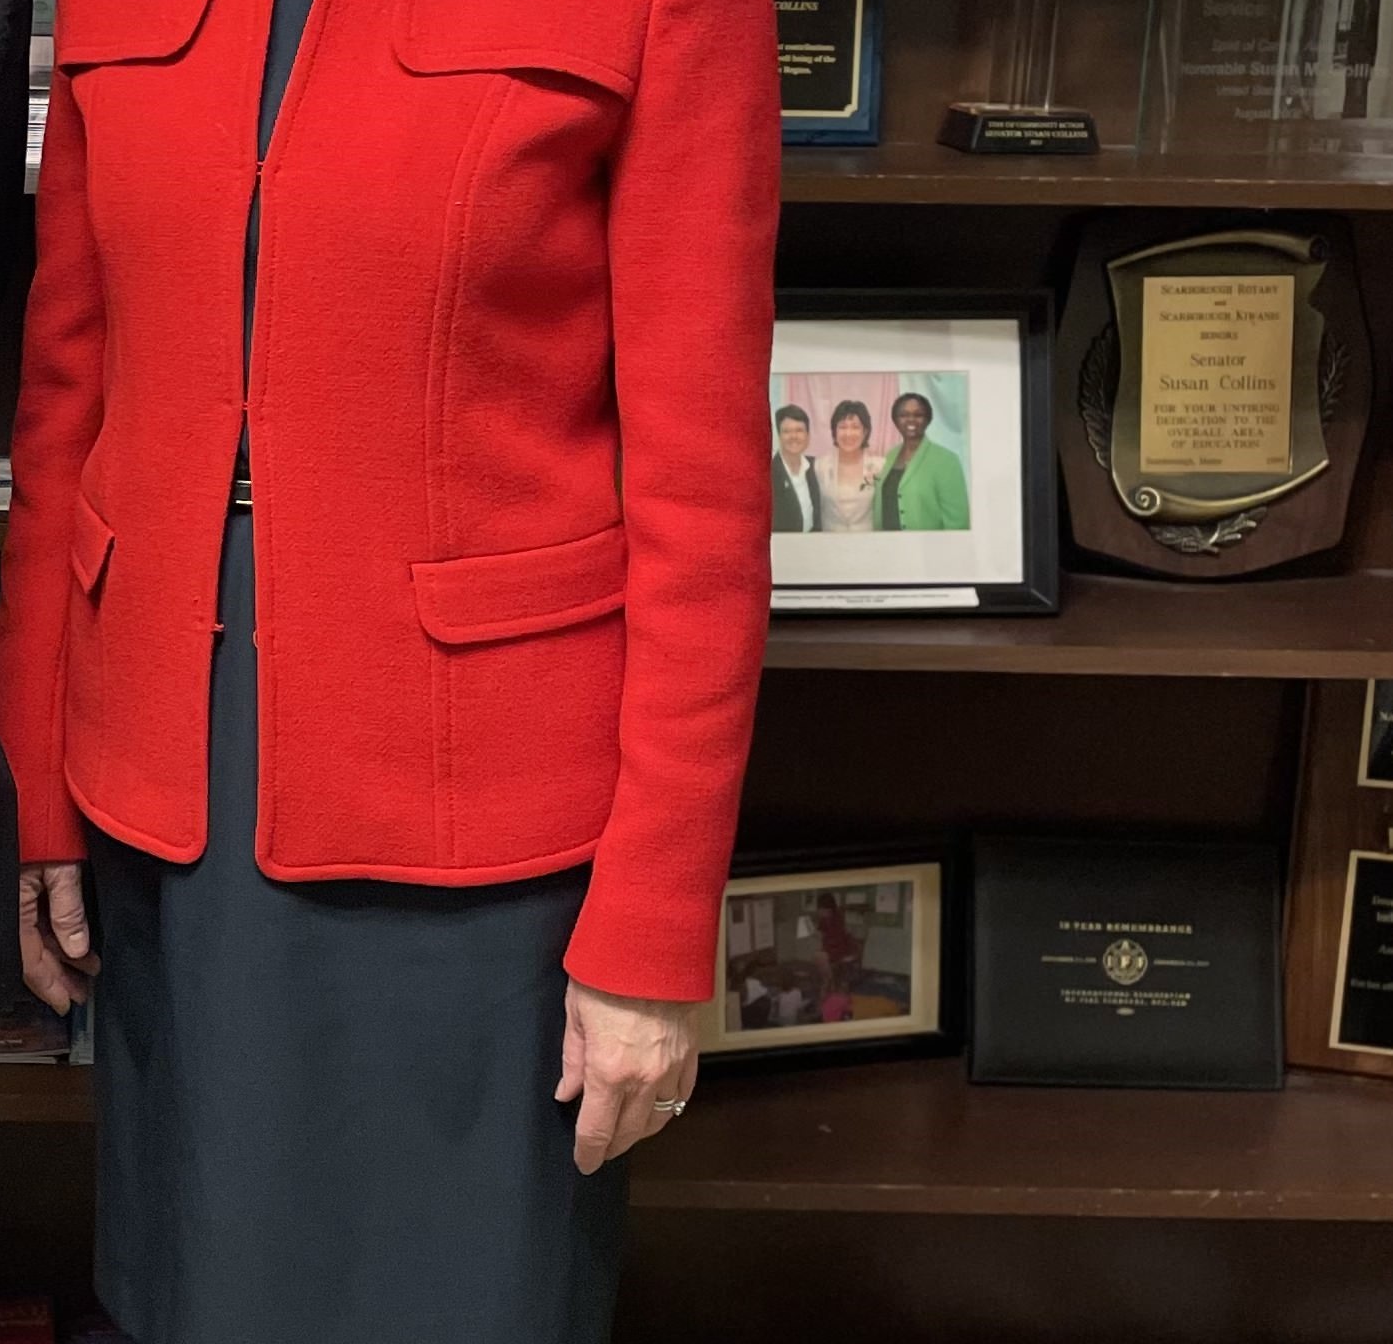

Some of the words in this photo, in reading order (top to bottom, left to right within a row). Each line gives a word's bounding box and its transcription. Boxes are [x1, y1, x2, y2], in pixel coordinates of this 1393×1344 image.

[774, 1, 819, 11] COLLINS
[1160, 284, 1233, 296] SCARBOROUGH
[1237, 284, 1279, 296] ROTARY
[1159, 311, 1232, 322] SCARBOROUGH
[1190, 352, 1247, 368] Senator
[1159, 374, 1209, 391] Susan
[1219, 374, 1277, 391] Collins
[1153, 403, 1176, 414] FOR
[1183, 403, 1216, 414] YOUR
[1222, 403, 1280, 414] UNTIRING
[1156, 415, 1227, 425] DEDICATION
[1233, 415, 1249, 425] TO
[1254, 415, 1277, 425] THE
[1167, 427, 1223, 437] OVERALL
[1231, 427, 1265, 437] AREA
[1171, 439, 1187, 449] OF
[1192, 439, 1261, 449] EDUCATION
[1106, 922, 1193, 935] REMEMBRANCE
